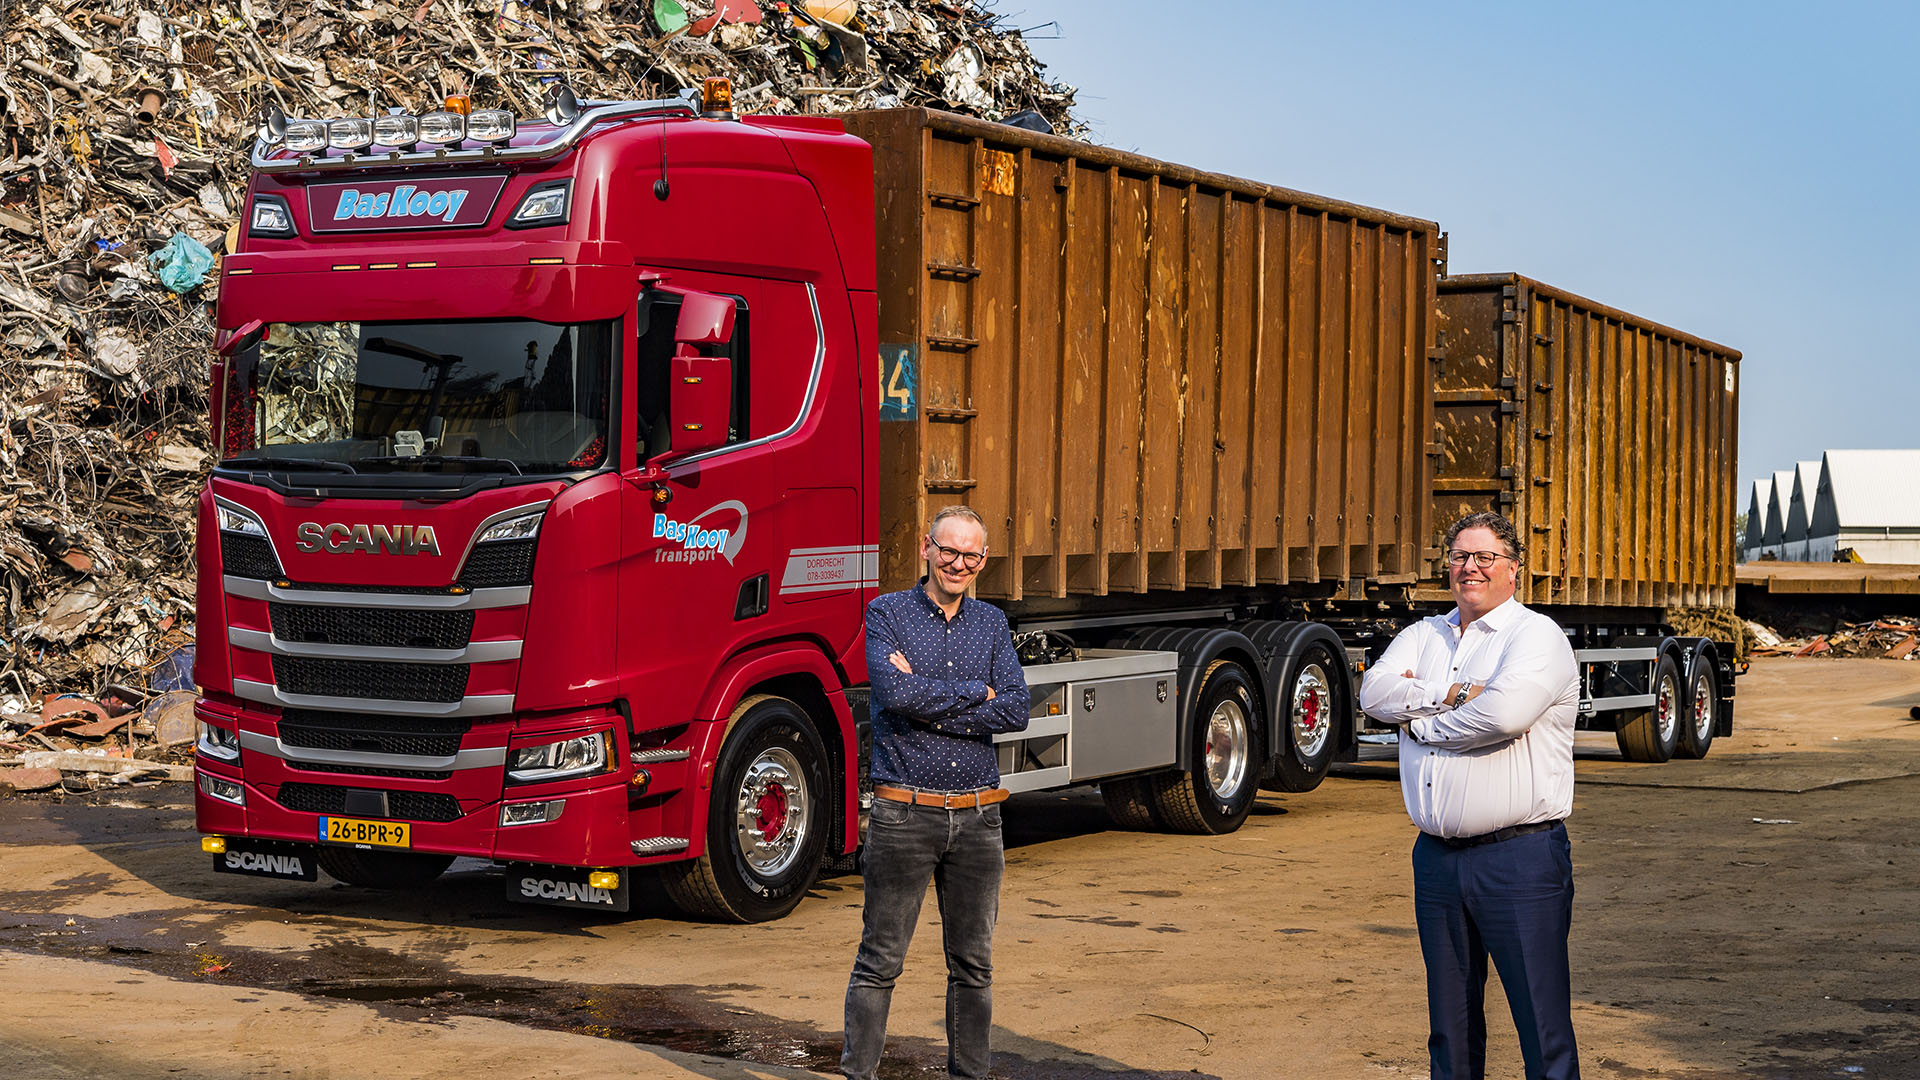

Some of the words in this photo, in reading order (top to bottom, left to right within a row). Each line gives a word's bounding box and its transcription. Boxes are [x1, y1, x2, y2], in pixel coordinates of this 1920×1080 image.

[334, 189, 391, 220] Bas
[387, 185, 469, 222] Kooy
[879, 350, 911, 413] 4
[296, 522, 441, 556] SCANIA
[653, 513, 687, 542] Bas
[684, 525, 729, 553] Kooy
[655, 548, 716, 565] Transport
[806, 557, 845, 569] DORDRECHT
[807, 570, 845, 581] 078-3039437
[332, 821, 404, 843] 26-BPR-9
[225, 850, 304, 875] SCANIA
[521, 878, 613, 904] SCANIA
